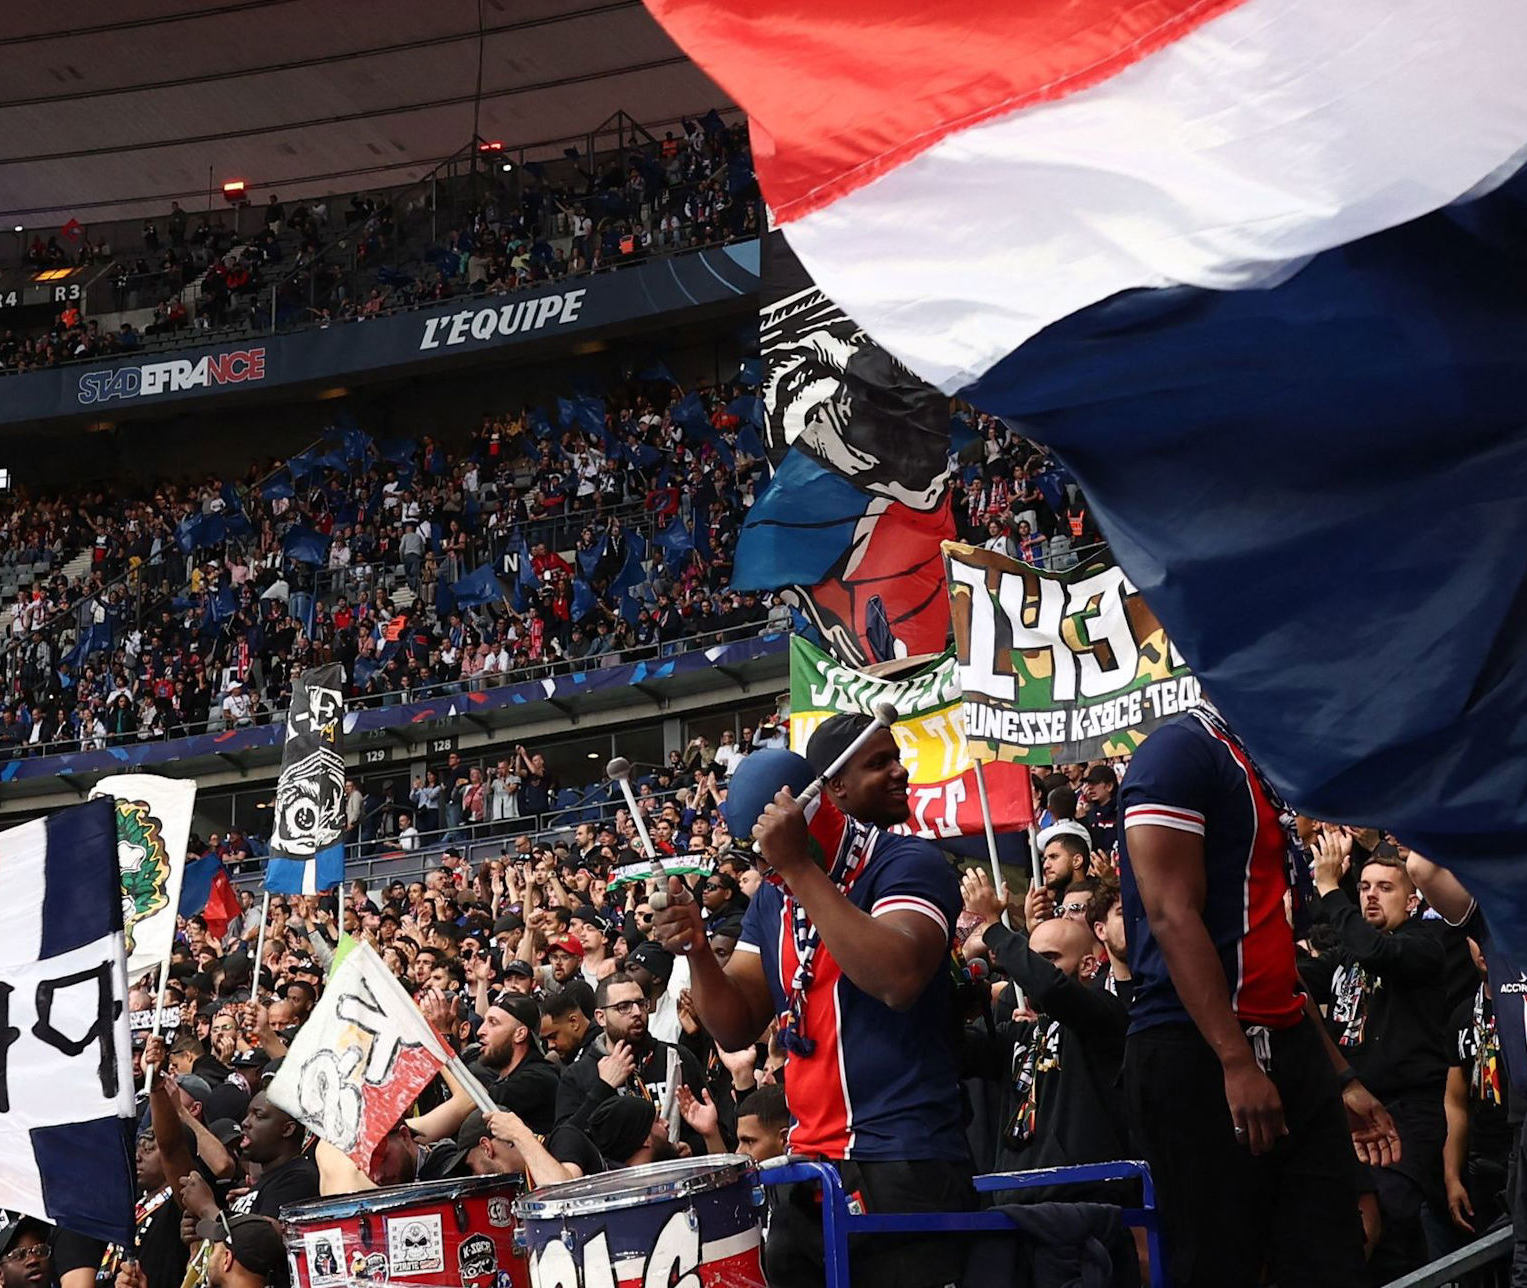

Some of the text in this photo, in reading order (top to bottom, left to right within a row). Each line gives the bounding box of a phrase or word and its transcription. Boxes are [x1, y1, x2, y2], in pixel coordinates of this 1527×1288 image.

[54, 284, 80, 302] R3
[419, 288, 587, 351] L'ÉQUIPE
[77, 347, 267, 405] STADEFRANCE
[950, 557, 1141, 702] 143
[963, 702, 1066, 744] EUNESSE
[365, 750, 386, 762] 129
[433, 739, 452, 752] 128
